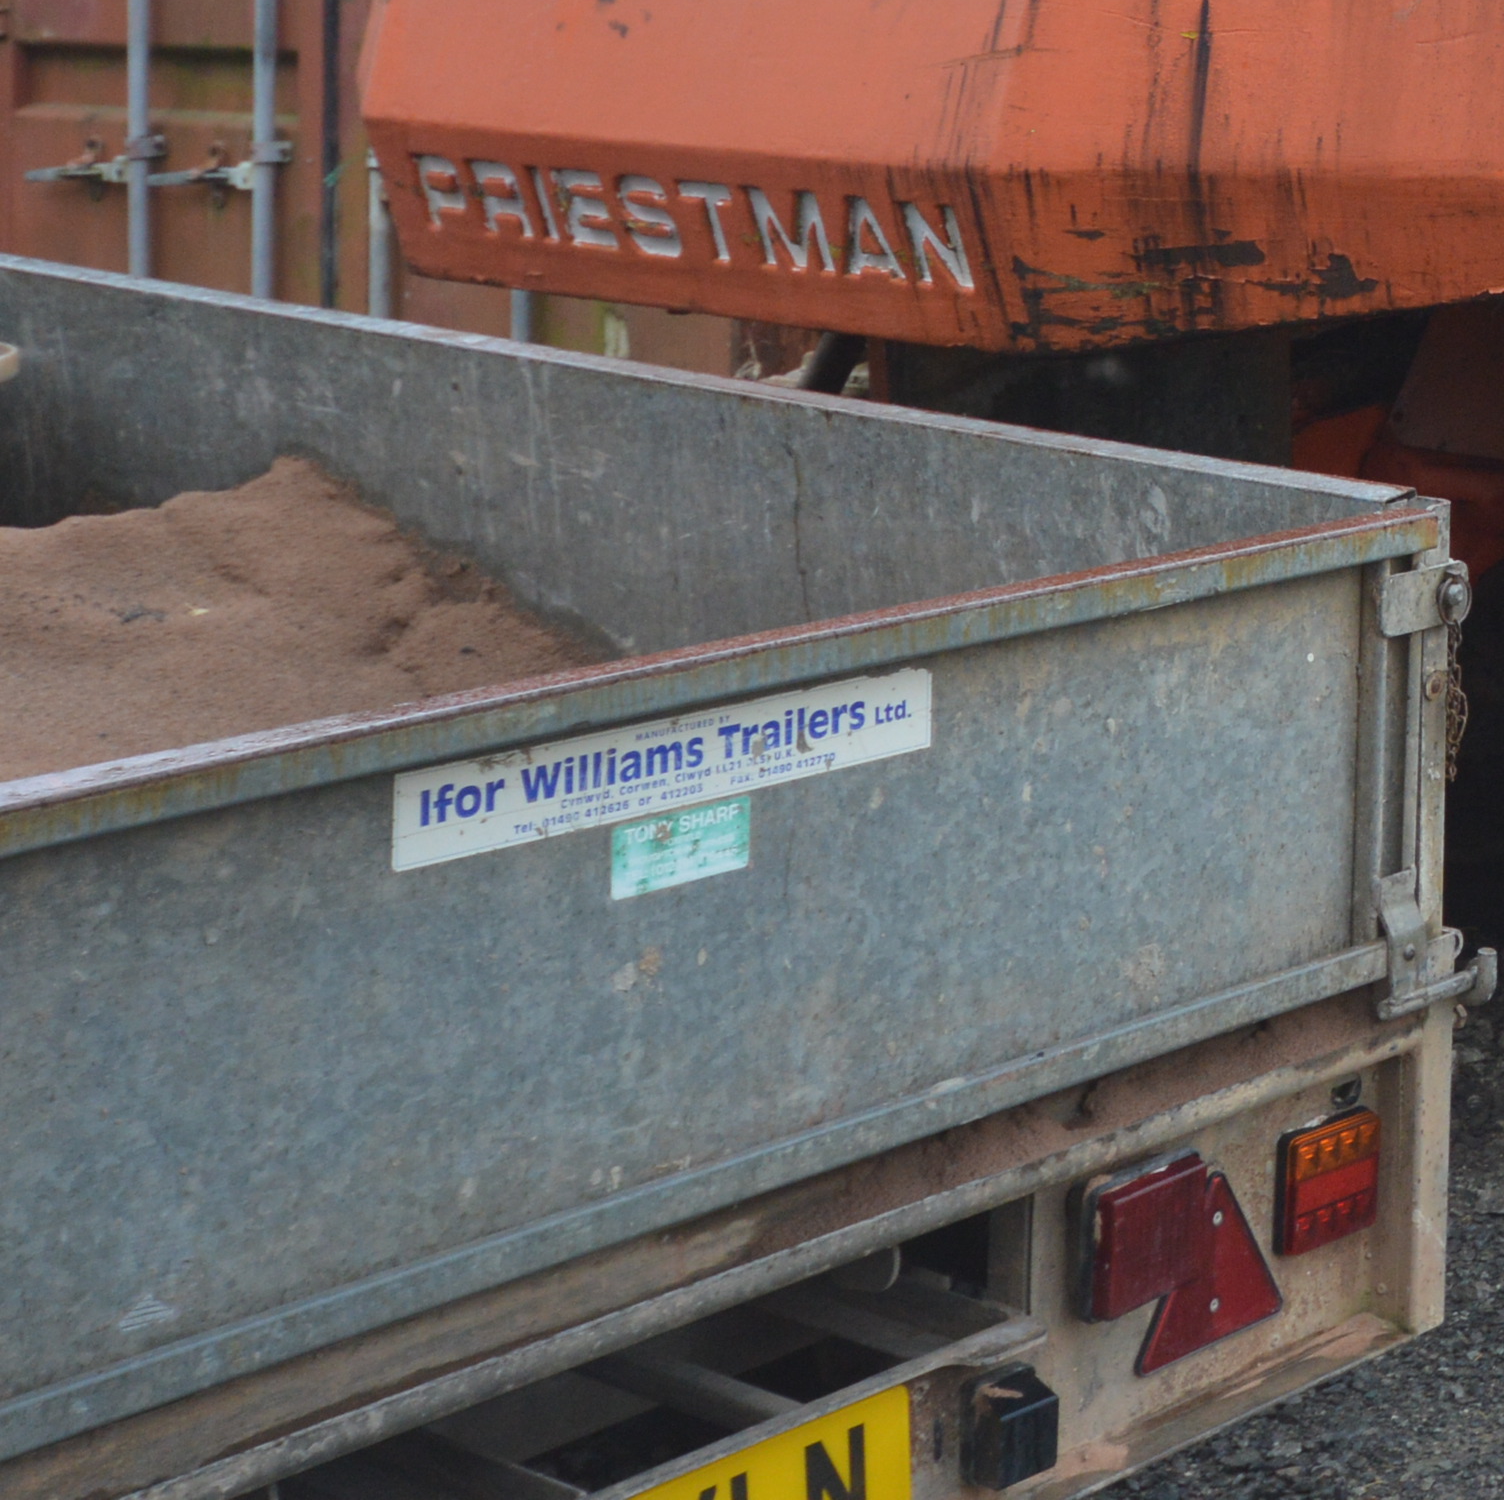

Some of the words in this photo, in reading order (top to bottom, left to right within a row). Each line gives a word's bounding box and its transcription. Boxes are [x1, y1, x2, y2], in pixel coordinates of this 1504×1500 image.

[411, 153, 975, 291] PRIESTMAN
[635, 718, 714, 741] MANUFACTURED
[719, 715, 730, 725] BY
[420, 778, 505, 827] Ifor
[521, 737, 704, 804] Williams
[717, 700, 865, 759] Trailers
[875, 699, 912, 726] Ltd.
[675, 766, 711, 783] Clwyd
[584, 800, 629, 818] 412626
[638, 795, 652, 807] or
